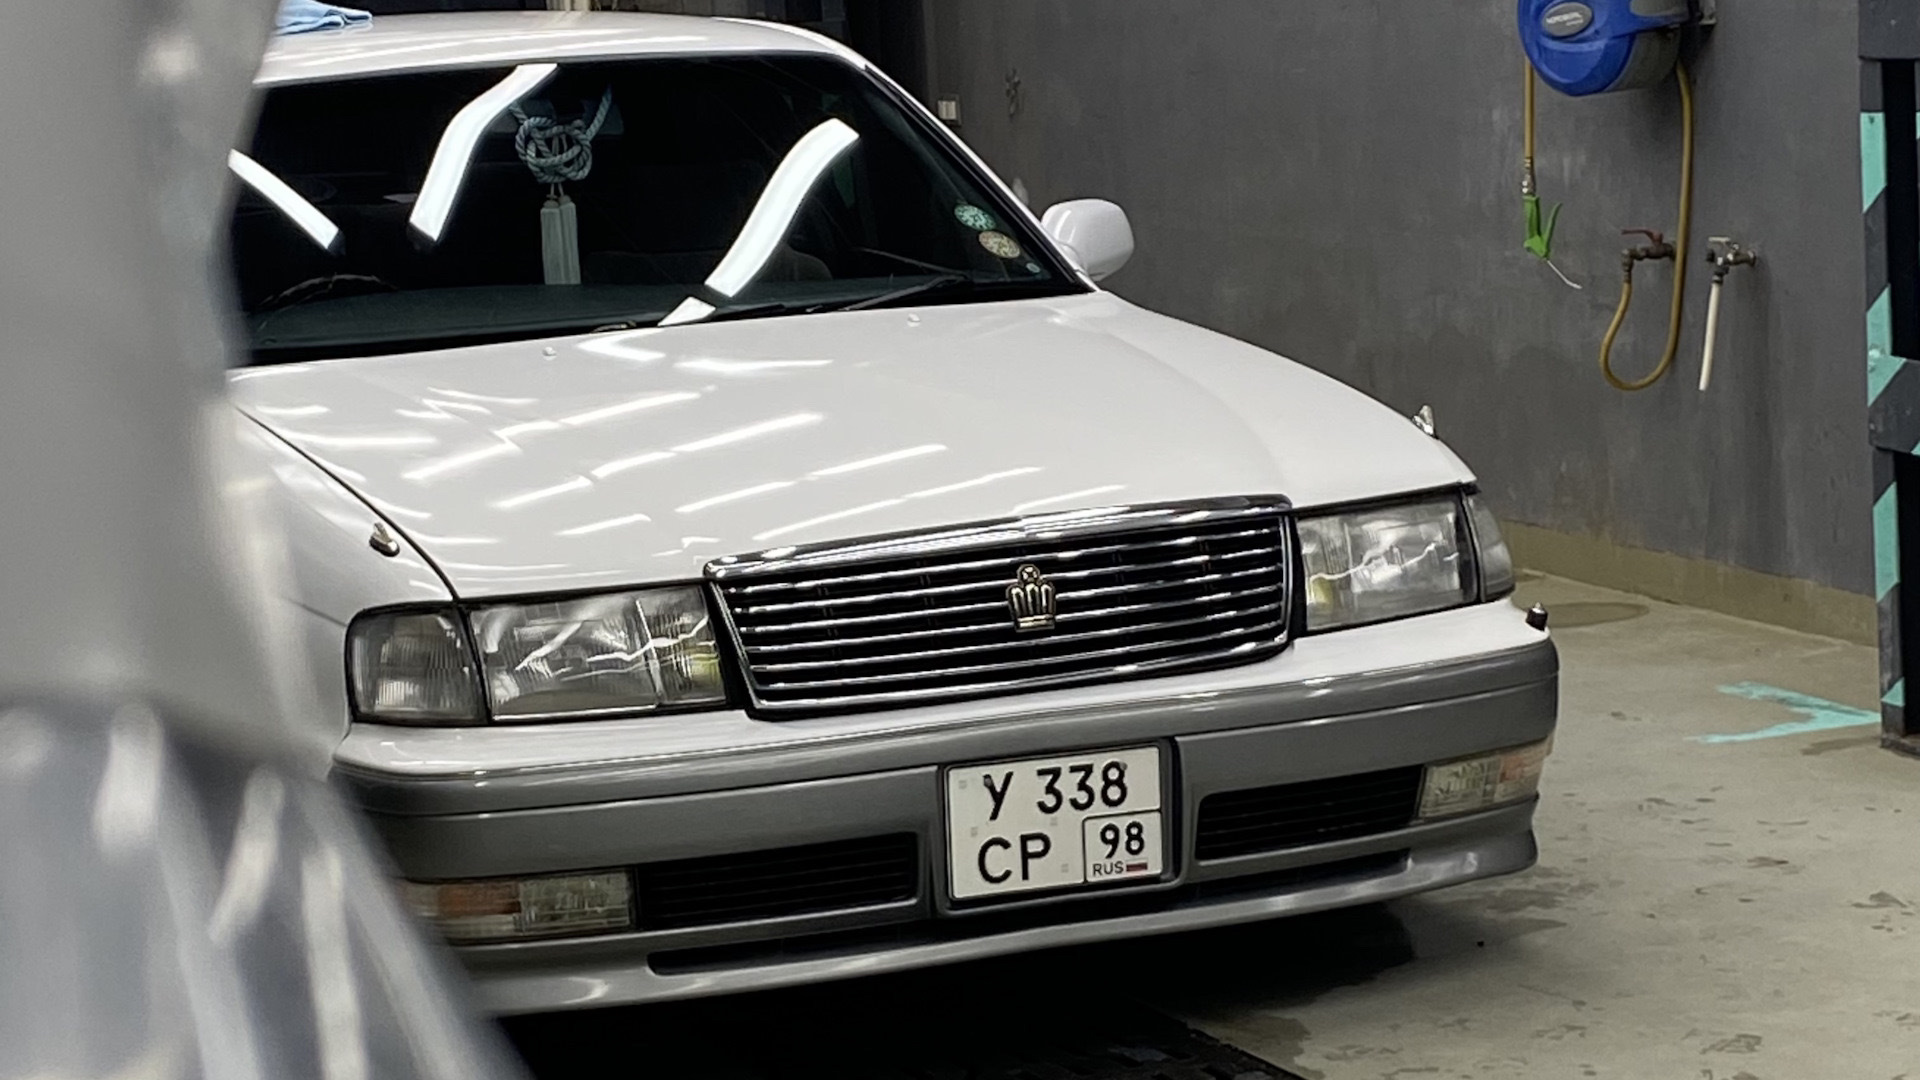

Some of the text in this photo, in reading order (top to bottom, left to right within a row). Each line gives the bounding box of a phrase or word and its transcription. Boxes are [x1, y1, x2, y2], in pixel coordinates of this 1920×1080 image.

[1036, 761, 1128, 814] 338
[978, 832, 1051, 884] СР
[1100, 821, 1145, 859] 98
[1093, 861, 1124, 876] RUS
